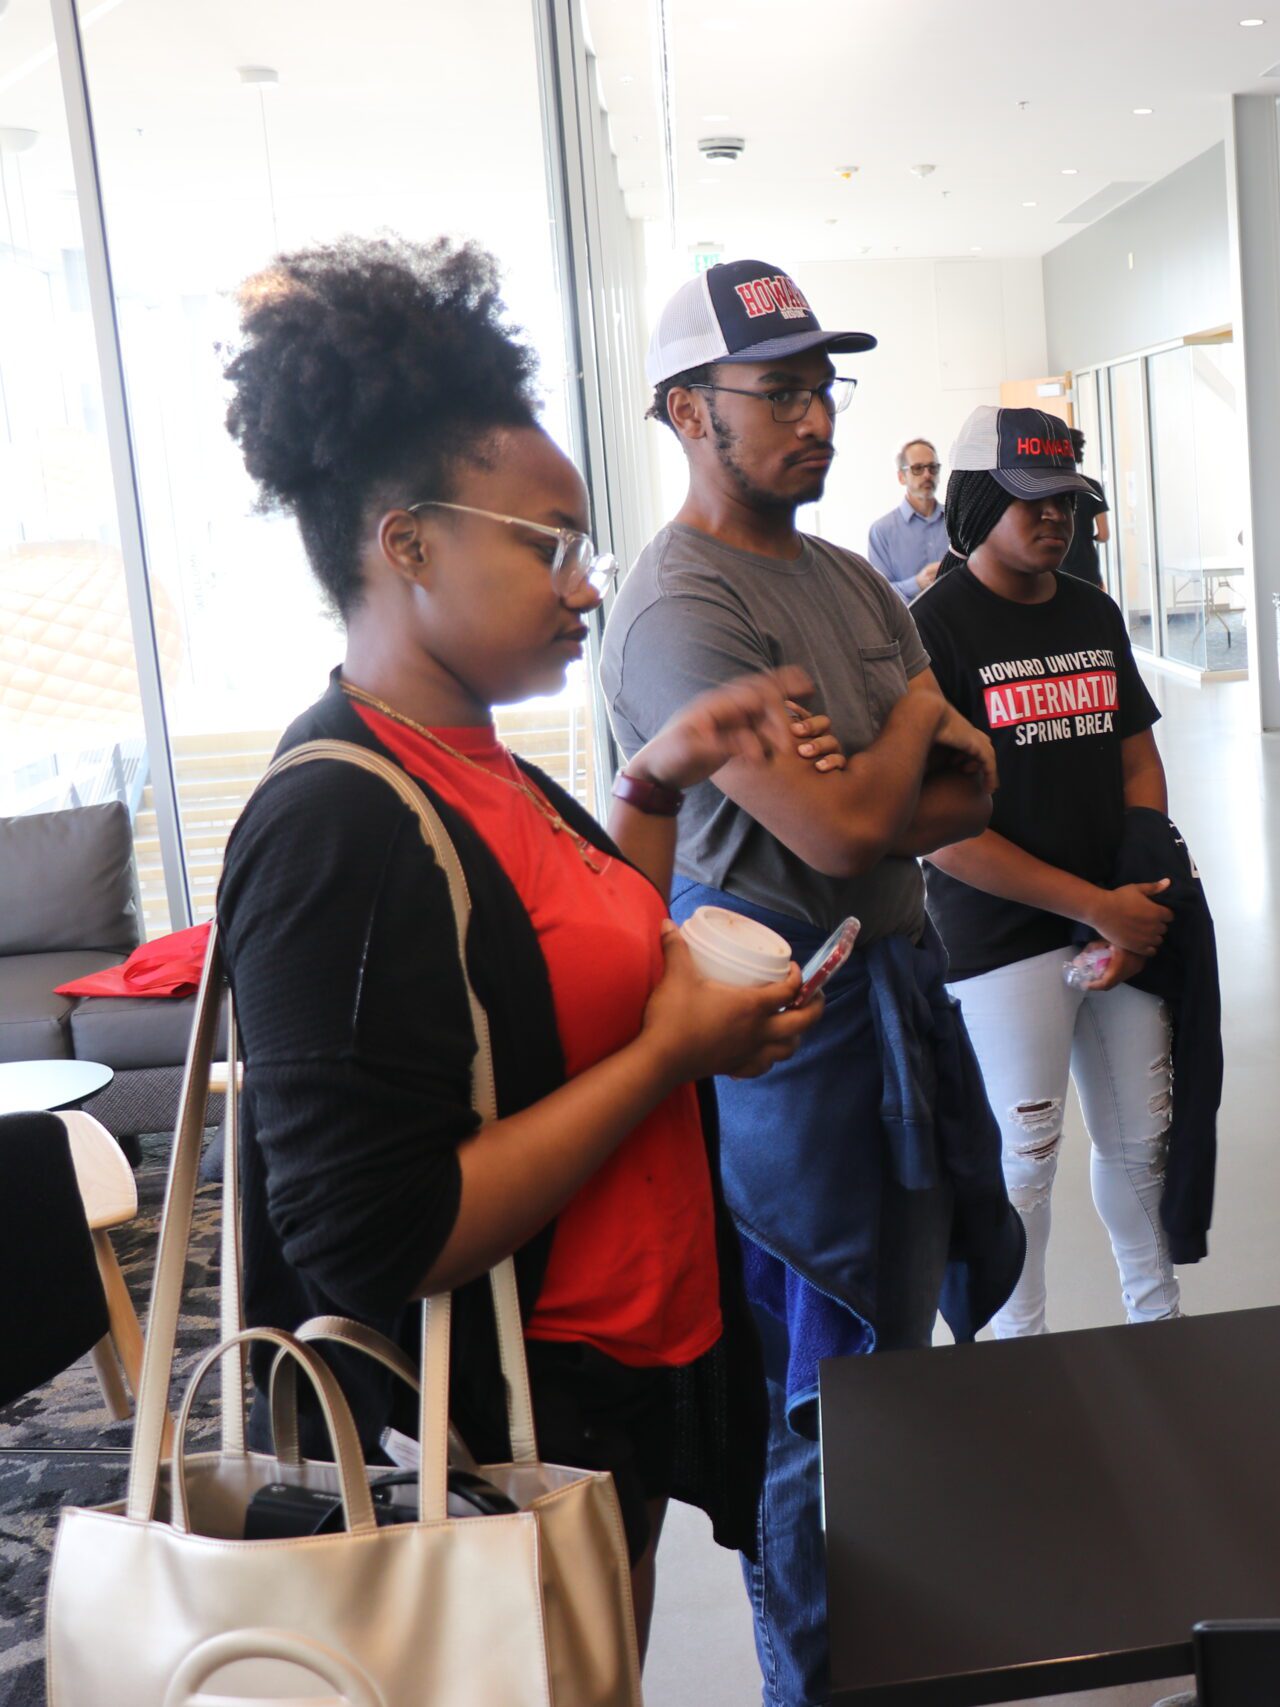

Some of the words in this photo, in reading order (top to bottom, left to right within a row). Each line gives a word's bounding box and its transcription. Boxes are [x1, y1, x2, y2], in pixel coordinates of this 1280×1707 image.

[979, 658, 1045, 685] HOWARD
[1044, 649, 1115, 674] UNIVERSIT
[989, 675, 1117, 724] ALTERNATIV
[1015, 718, 1072, 746] SPRING
[1075, 711, 1114, 737] BREA
